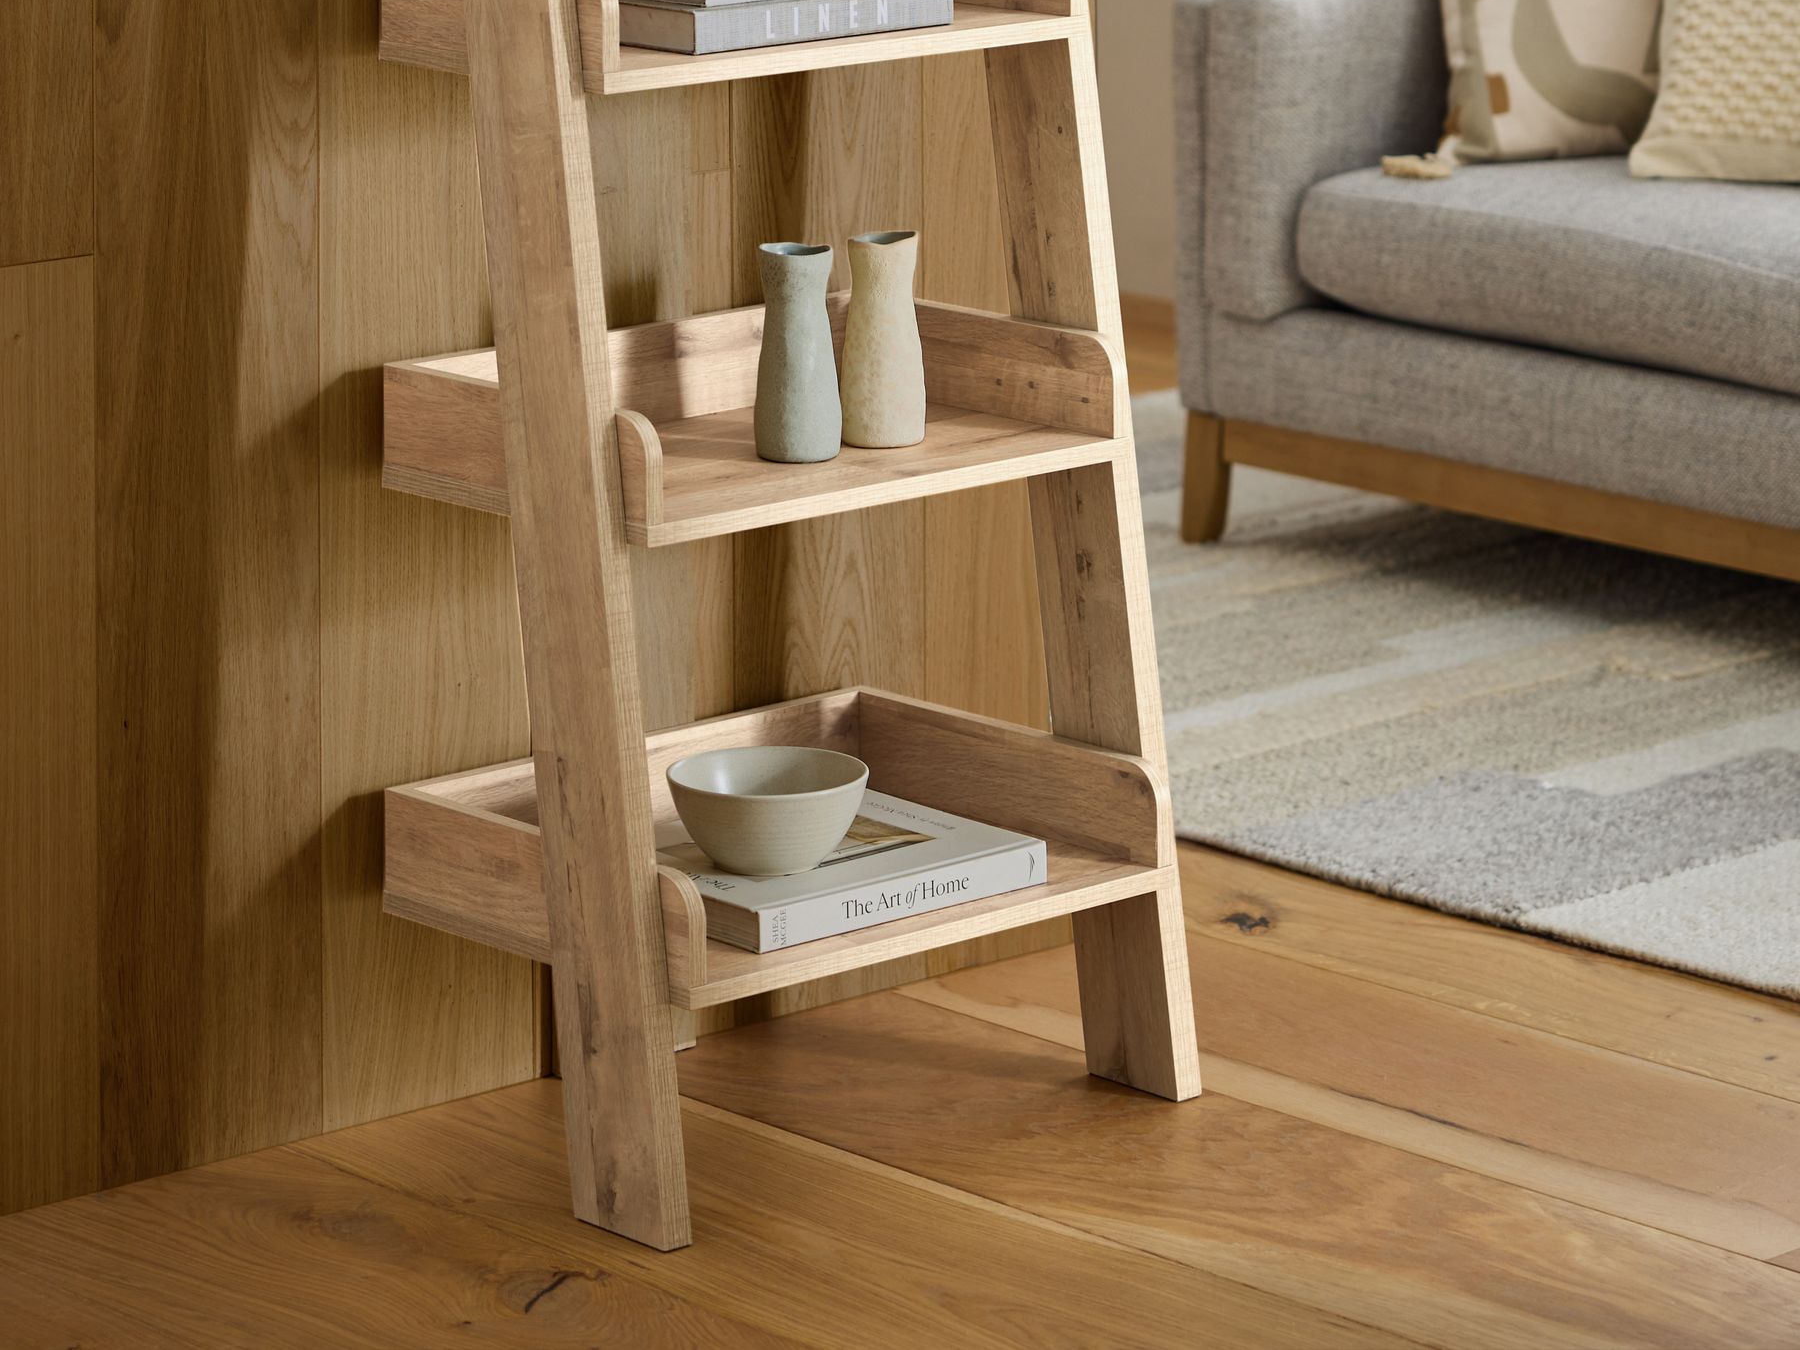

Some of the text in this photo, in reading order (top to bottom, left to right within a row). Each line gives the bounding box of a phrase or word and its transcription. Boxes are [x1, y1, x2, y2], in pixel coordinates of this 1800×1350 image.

[842, 877, 969, 919] The Art of Home
